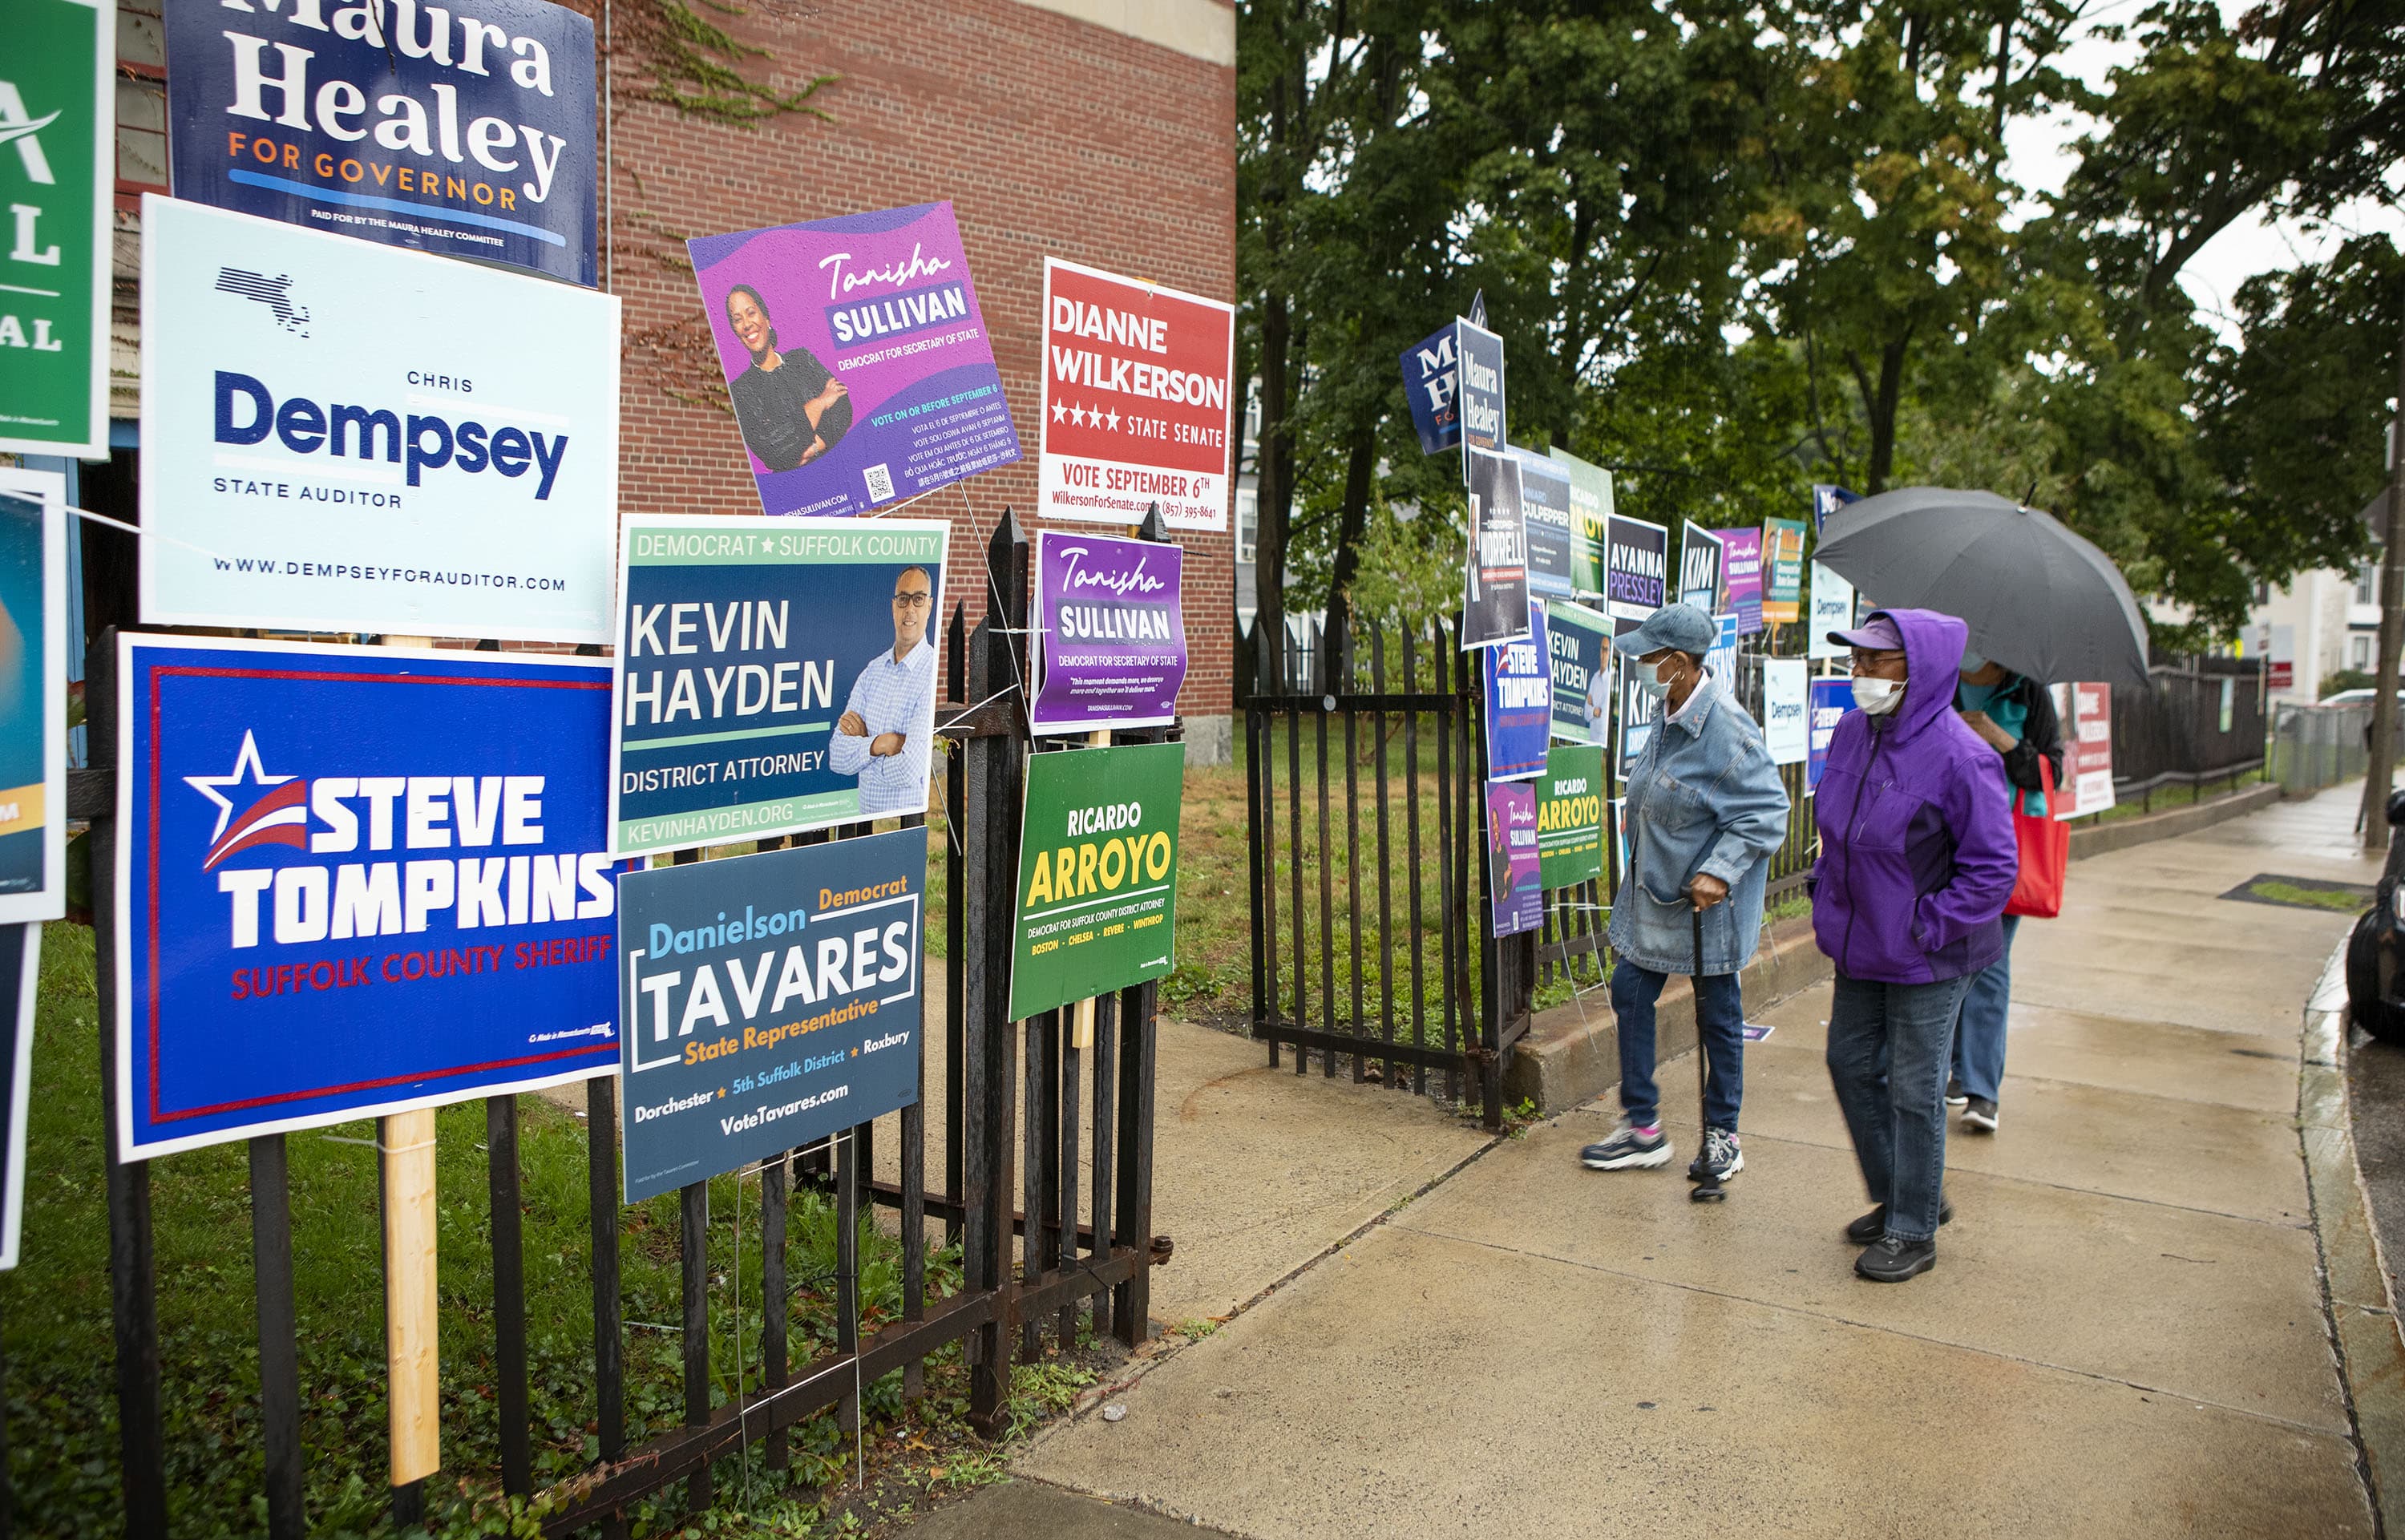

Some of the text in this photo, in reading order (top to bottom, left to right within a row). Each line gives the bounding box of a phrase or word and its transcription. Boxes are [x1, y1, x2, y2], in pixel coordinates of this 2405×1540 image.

[221, 0, 554, 97] aura
[223, 30, 566, 203] Healey
[228, 132, 515, 212] FOR GOVERNOR
[311, 209, 504, 247] PAID FOR BY THE MAURA HEALEY COMMITTEE
[819, 242, 952, 300] Tanisha
[833, 287, 966, 342] SULLIVAN
[1052, 294, 1168, 354] DIANNE
[838, 328, 980, 371] DEMOCRAT FOR SECRETARY OF STATE
[406, 370, 474, 394] CHRIS
[1051, 345, 1224, 410] WILKERSON
[1464, 350, 1498, 394] Maura
[871, 384, 998, 427] VOTE ON OR BEFORE SEPTEMBER 6
[911, 424, 928, 435] VOTA
[936, 418, 941, 427] 6
[941, 417, 948, 426] DE
[980, 406, 984, 414] O
[985, 402, 1001, 413] ANTES
[1433, 410, 1454, 426] FO
[1465, 393, 1500, 443] Healey
[214, 370, 569, 500] Dempsey
[907, 453, 924, 463] VOTE
[934, 446, 943, 455] OU
[944, 441, 961, 453] ANTES
[962, 437, 969, 447] DE
[970, 435, 974, 444] 6
[975, 434, 982, 443] DE
[913, 437, 928, 448] VOTE
[929, 432, 942, 443] SOU
[961, 422, 976, 434] AVAN
[977, 419, 982, 429] 6
[984, 443, 988, 452] 6
[1007, 437, 1011, 445] 9
[1127, 415, 1223, 448] STATE SENATE
[213, 477, 402, 509] STATE AUDITOR
[1063, 463, 1210, 499] VOTE SEPTEMBER 6TH
[781, 493, 848, 517] ISHASULLIVAN.COM
[1053, 491, 1216, 520] WilkersonForSenate.com (857) 395-8641
[1523, 500, 1569, 527] CULPEPPER
[1569, 503, 1604, 540] RROY
[637, 534, 938, 557] DEMOCRAT SUFFOLK COUNTY
[1481, 531, 1524, 567] WORRELL
[1611, 543, 1663, 579] AYANNA
[213, 557, 566, 592] WWW.DEMPSEYFORAUDITOR.COM
[1060, 547, 1165, 596] Tanisha
[1684, 547, 1715, 592] KIM
[1728, 560, 1759, 576] SULLIVAN
[1610, 571, 1663, 604] PRESSLEY
[1061, 605, 1170, 640] SULLIVAN
[1817, 598, 1846, 620] Dempsey
[630, 600, 789, 657] KEVIN
[1547, 629, 1579, 661] KEVIN
[1058, 655, 1178, 667] DEMOCRAT FOR SECRETARY OF STATE
[1508, 644, 1538, 674] STEVE
[625, 659, 835, 726] HAYDEN
[1497, 677, 1548, 709] TOMPKINS
[1772, 701, 1802, 723] Dempsey
[623, 750, 825, 794] DISTRICT ATTORNEY
[1554, 778, 1587, 796] RICARDO
[311, 775, 546, 854] STEVE
[628, 803, 794, 845] KEVINHAYDEN.ORG
[1067, 801, 1142, 837] RICARDO
[1508, 800, 1534, 824] Tanisha
[1538, 794, 1600, 832] ARROYO
[1510, 829, 1536, 847] SULLIVAN
[1025, 831, 1171, 907] ARROYO
[218, 851, 616, 948] TOMPKINS
[819, 875, 907, 911] Democrat
[649, 904, 806, 960] Danielson
[1028, 897, 1165, 939] DEMOCRAT FOR SUFFOLK COUNTY DISTRICT ATTORNEY
[1032, 913, 1164, 956] BOSTON CHELSEA REVERE WINTHROP
[231, 934, 613, 1000] SUFFOLK COUNTY SHERIFF
[641, 921, 909, 1042] TAVARES
[684, 998, 879, 1066] State Representative
[635, 1029, 911, 1124] Dorchester 5th Suffolk District Roxbury
[721, 1082, 848, 1136] VoteTavares.com
